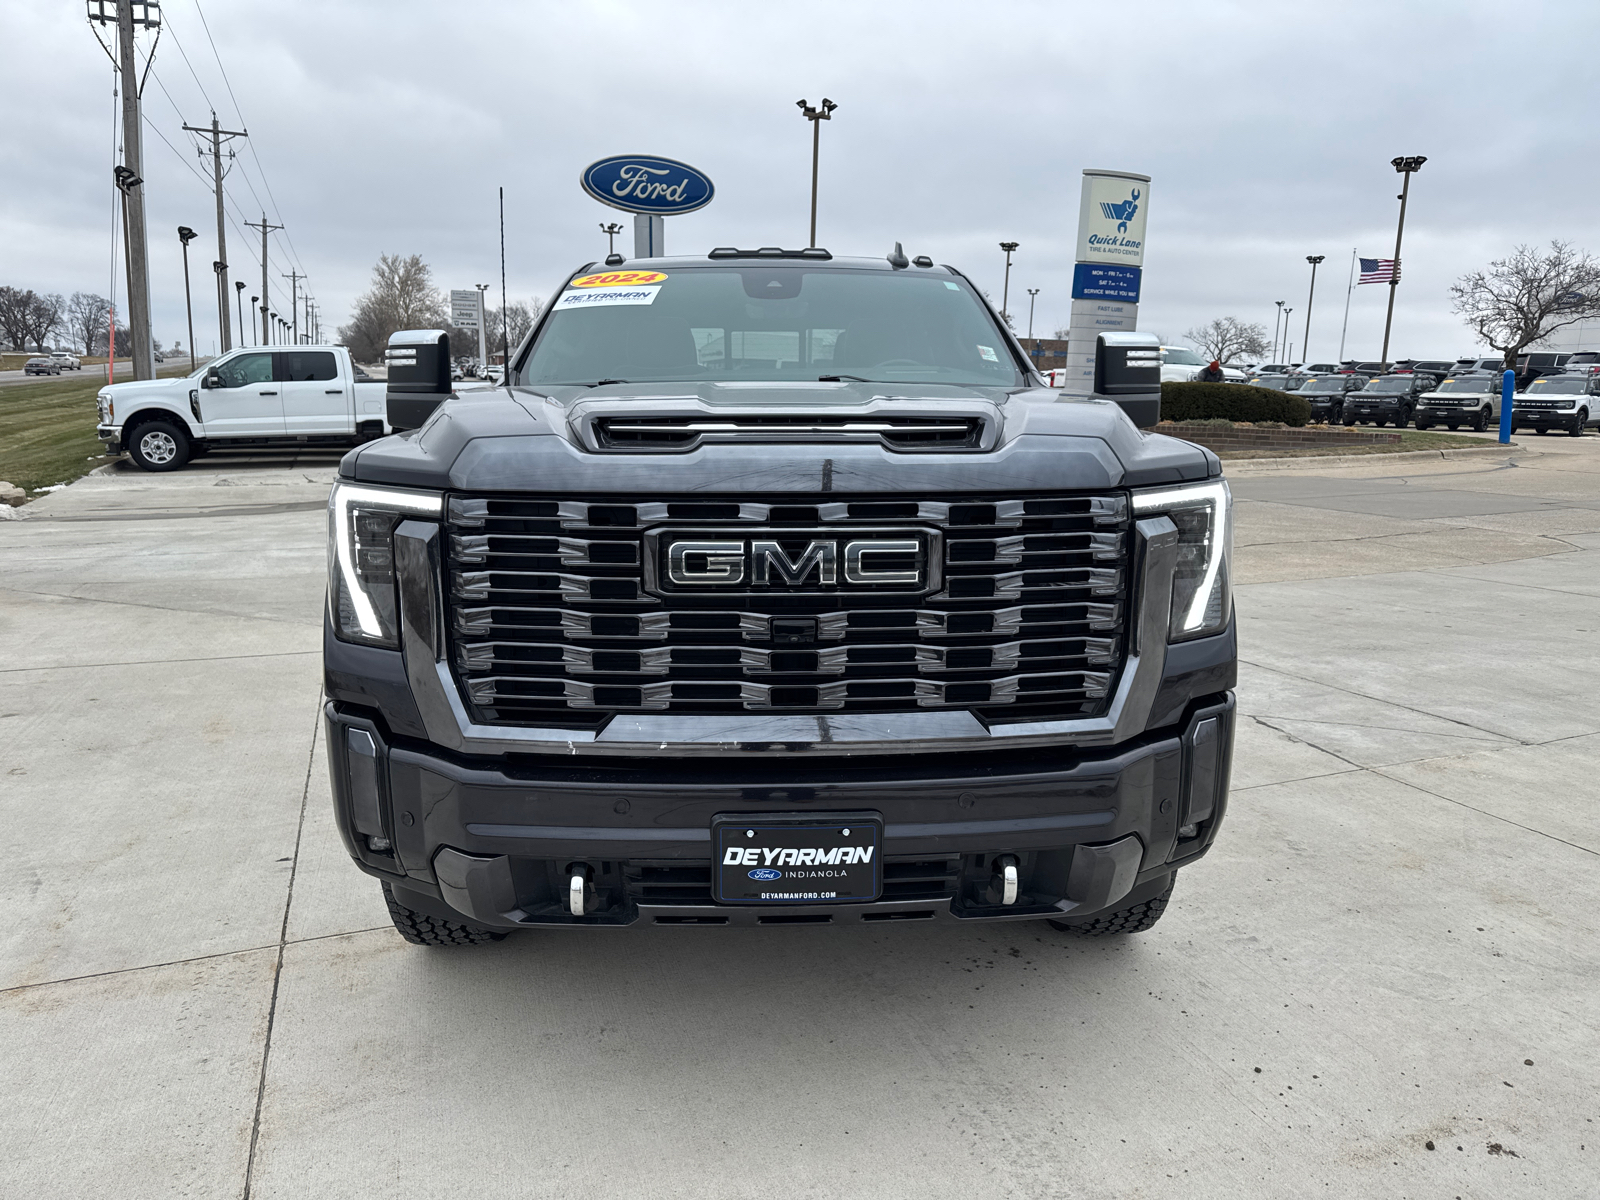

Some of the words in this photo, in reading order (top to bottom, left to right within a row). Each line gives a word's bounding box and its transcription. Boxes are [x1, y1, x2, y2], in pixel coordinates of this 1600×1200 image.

[612, 164, 689, 202] Ford
[1088, 234, 1119, 245] Quick
[1119, 237, 1142, 249] Lane
[1107, 247, 1122, 255] AUTO
[1122, 249, 1140, 257] CENTER
[578, 273, 660, 286] 2024
[563, 291, 653, 303] DEYARMAN
[457, 310, 473, 318] Jeep
[668, 539, 919, 585] GMC
[723, 846, 874, 866] DEYARMAN
[754, 870, 775, 879] Ford
[785, 869, 848, 878] INDIANOLA
[761, 891, 837, 899] DEYARMANFORD.COM
